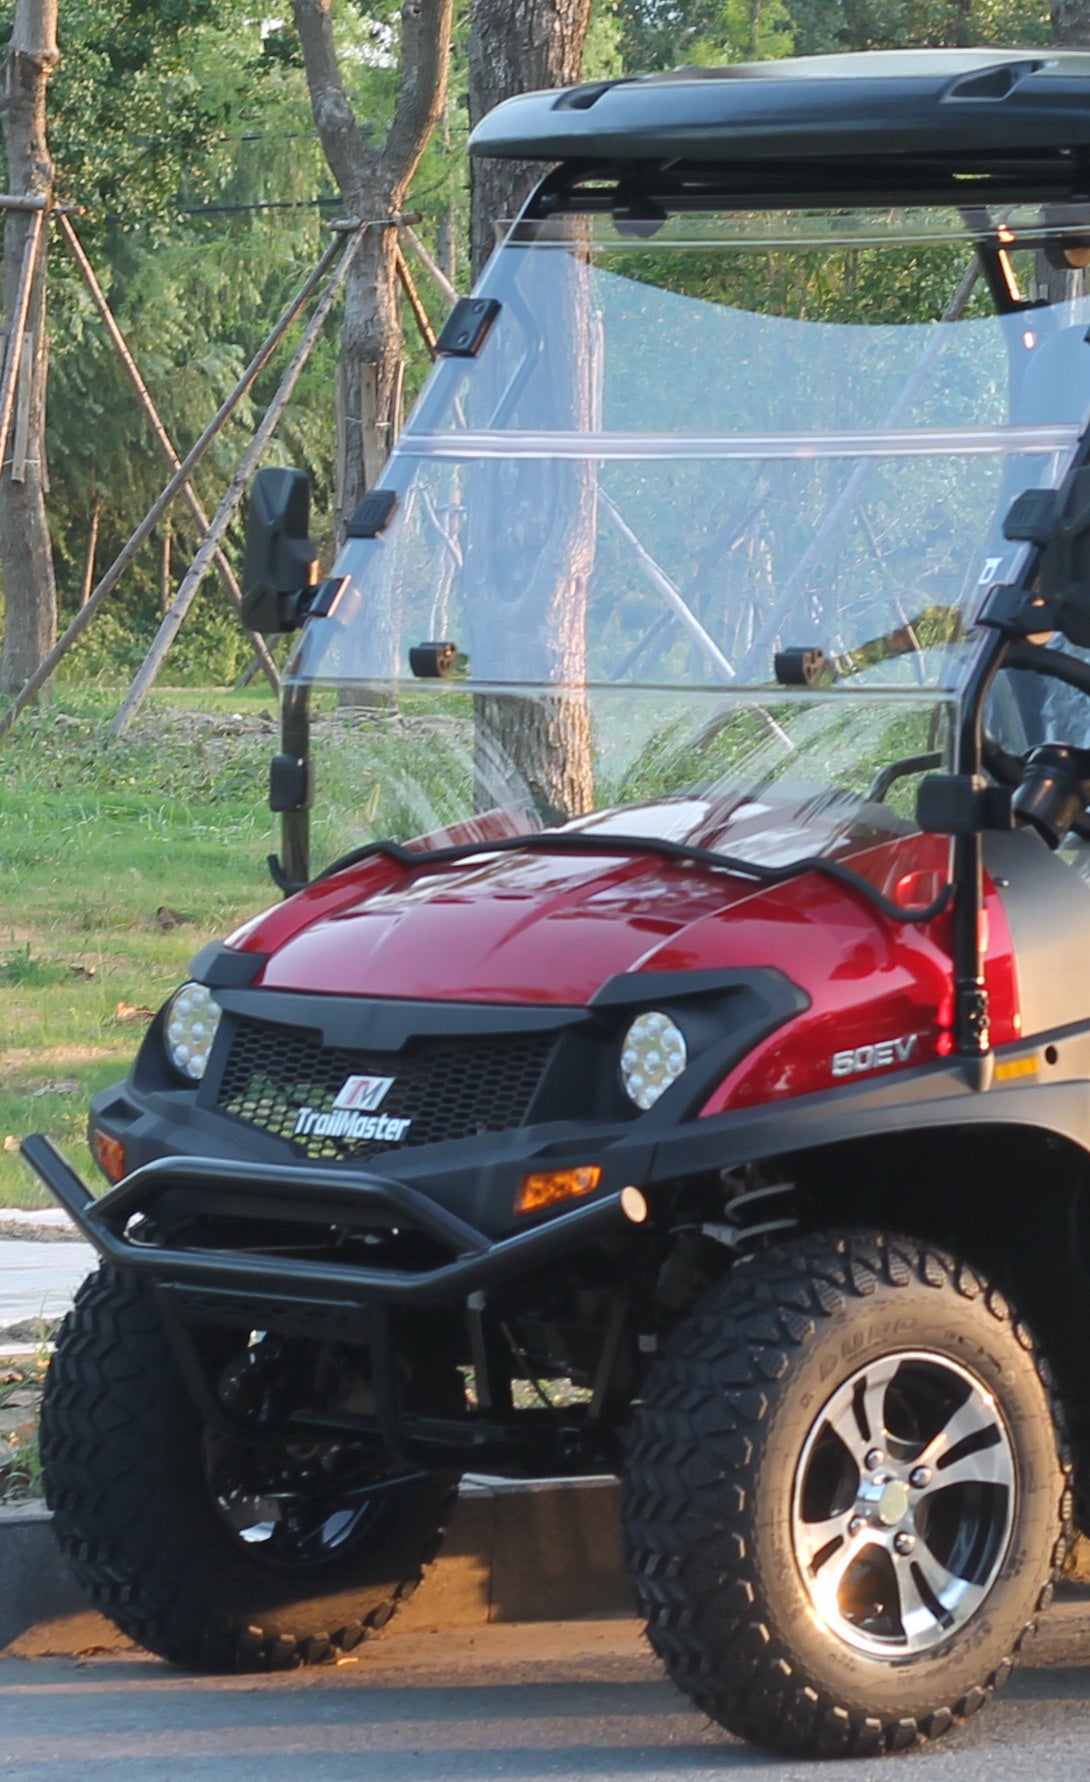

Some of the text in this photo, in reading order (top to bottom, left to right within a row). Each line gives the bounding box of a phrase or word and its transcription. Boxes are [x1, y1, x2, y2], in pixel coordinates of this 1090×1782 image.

[831, 1033, 918, 1077] 60EV
[342, 1079, 387, 1108] TM
[294, 1106, 412, 1141] TrailMaster
